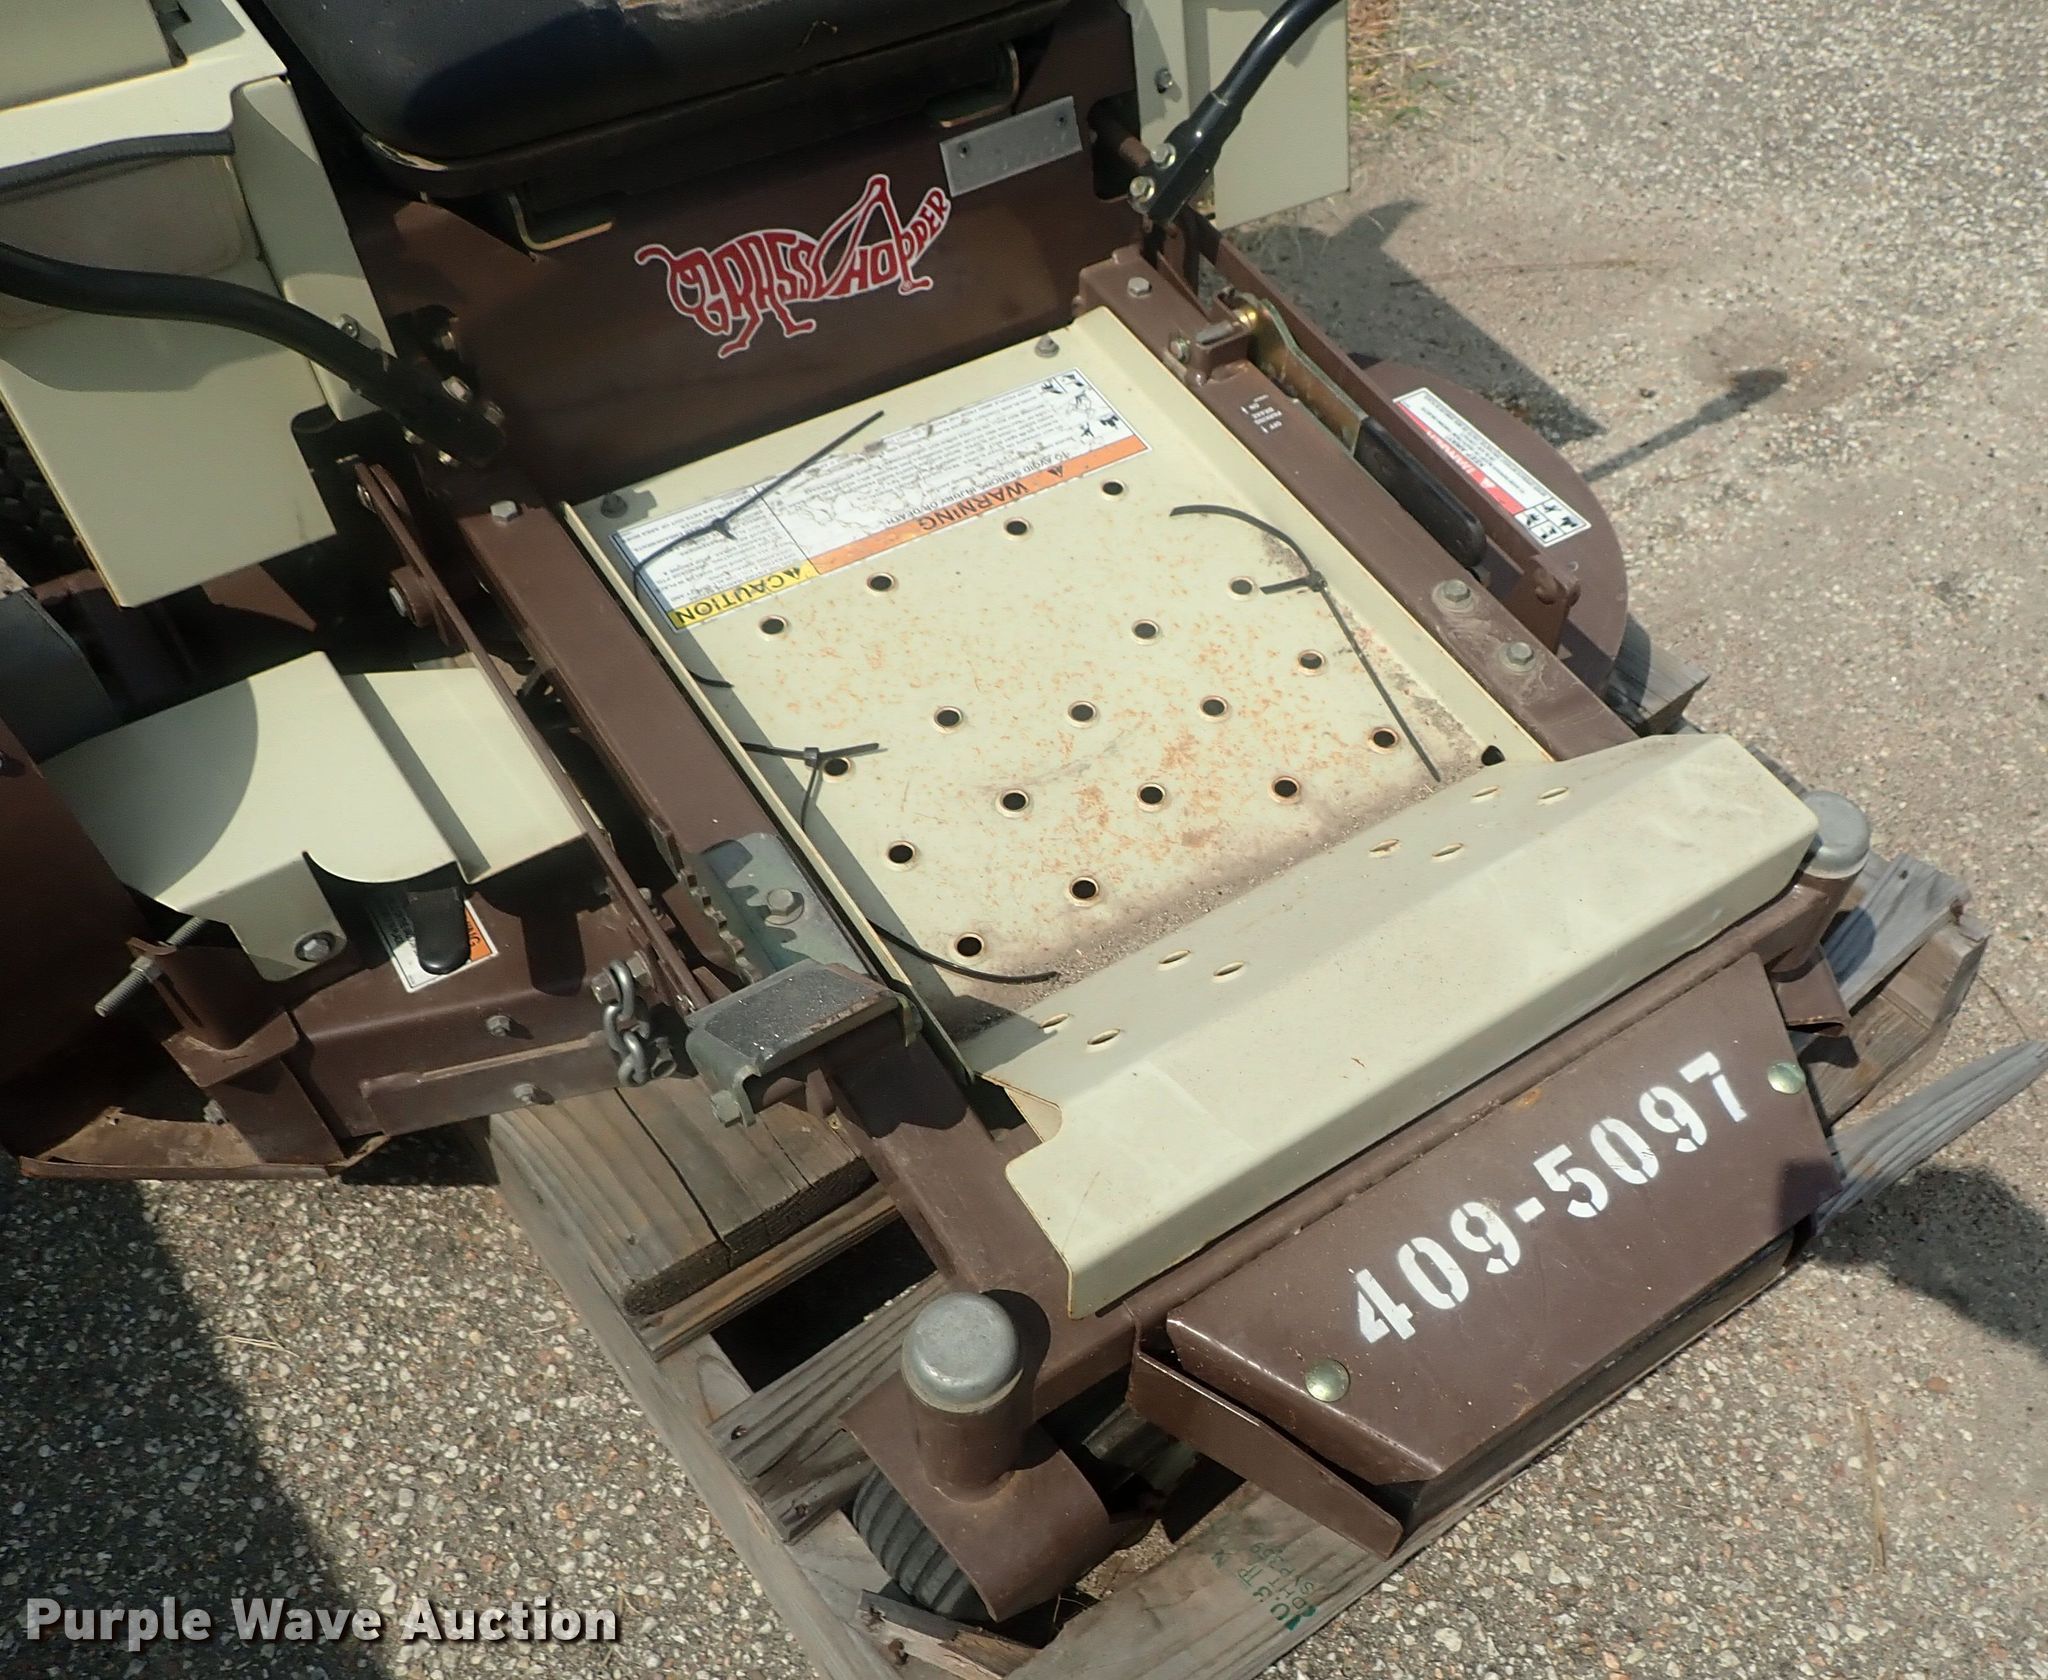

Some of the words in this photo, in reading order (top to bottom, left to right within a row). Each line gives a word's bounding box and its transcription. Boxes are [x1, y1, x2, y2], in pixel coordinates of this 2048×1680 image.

[650, 176, 950, 354] GRASSHOPPER
[1024, 454, 1055, 474] AVOID
[919, 482, 1029, 531] WARNING
[675, 573, 785, 624] CAUTION
[1355, 1051, 1748, 1344] 409-5097
